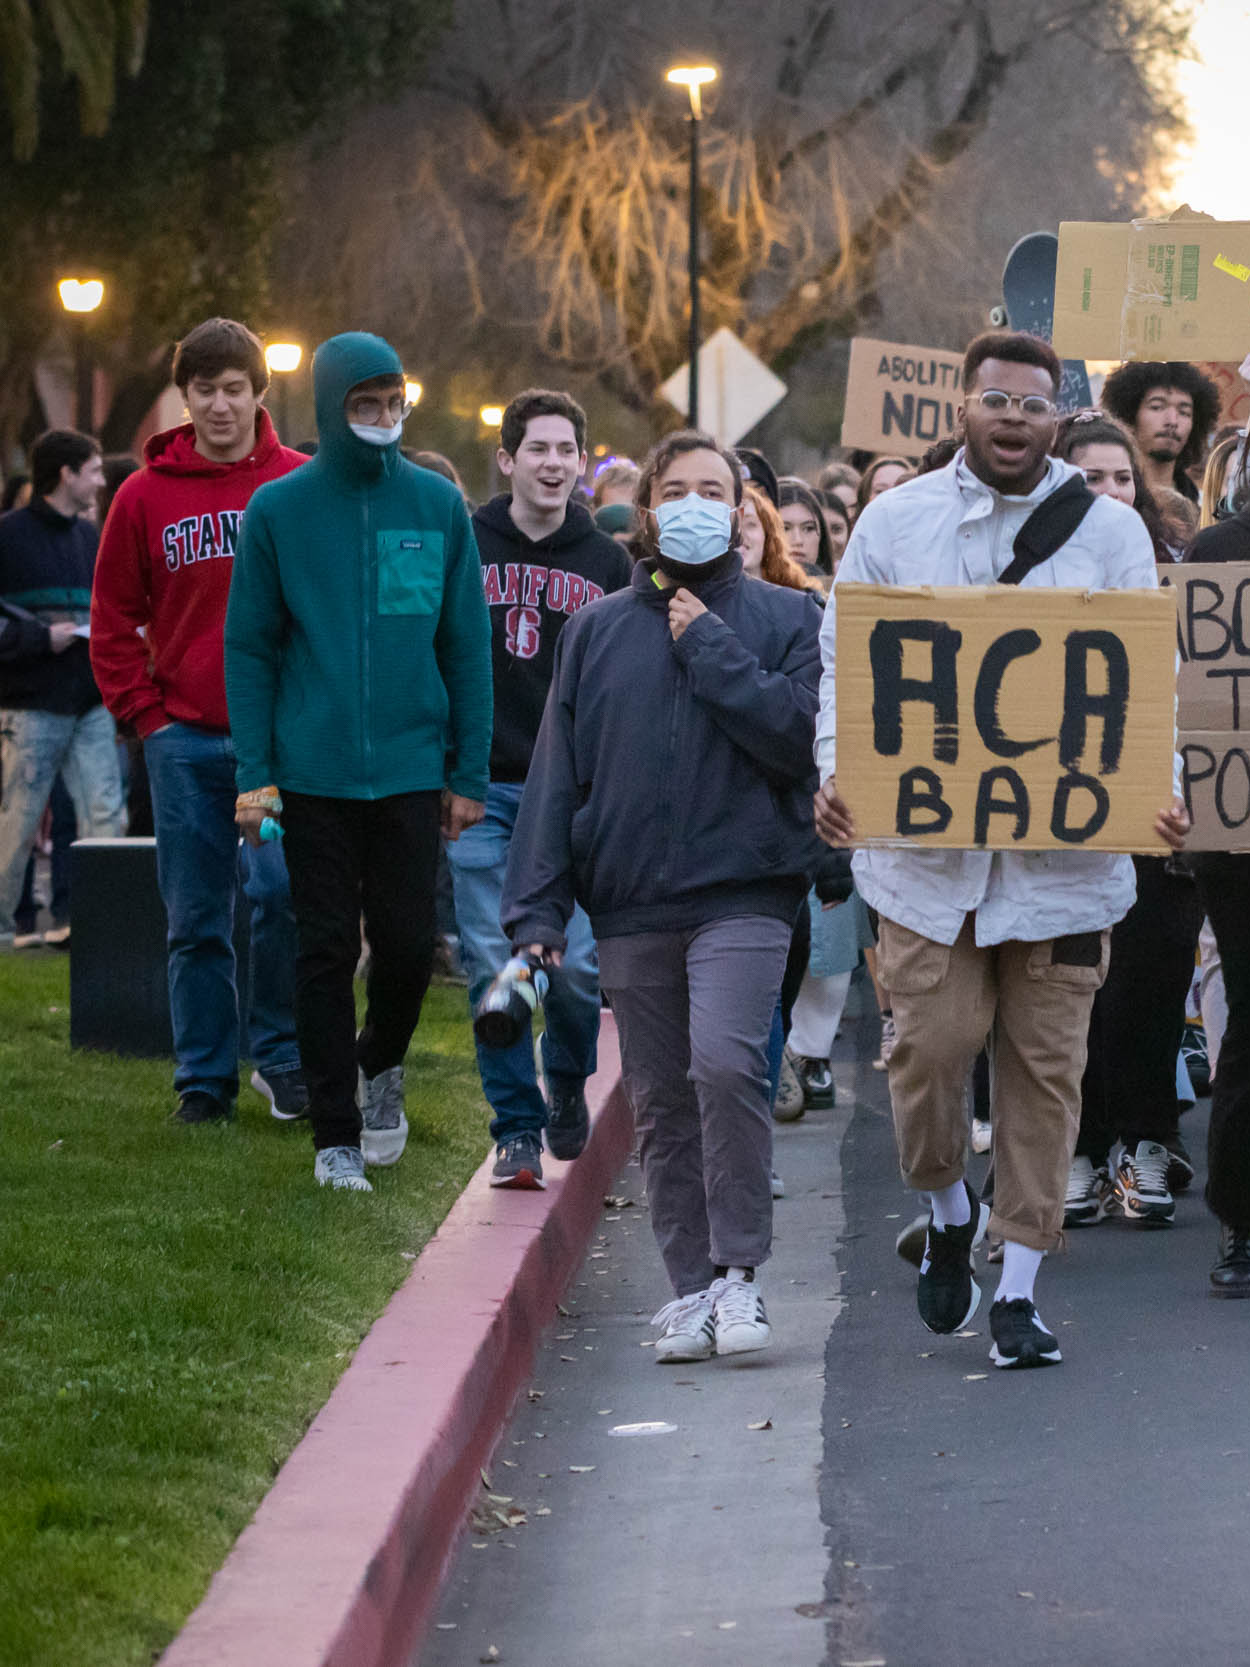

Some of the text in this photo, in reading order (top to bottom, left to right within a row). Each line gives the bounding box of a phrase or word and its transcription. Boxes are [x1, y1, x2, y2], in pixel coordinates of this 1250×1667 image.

[878, 356, 960, 390] ABOLITI
[163, 510, 247, 573] STAN
[481, 563, 604, 615] ANFOR
[896, 766, 1110, 844] BAD
